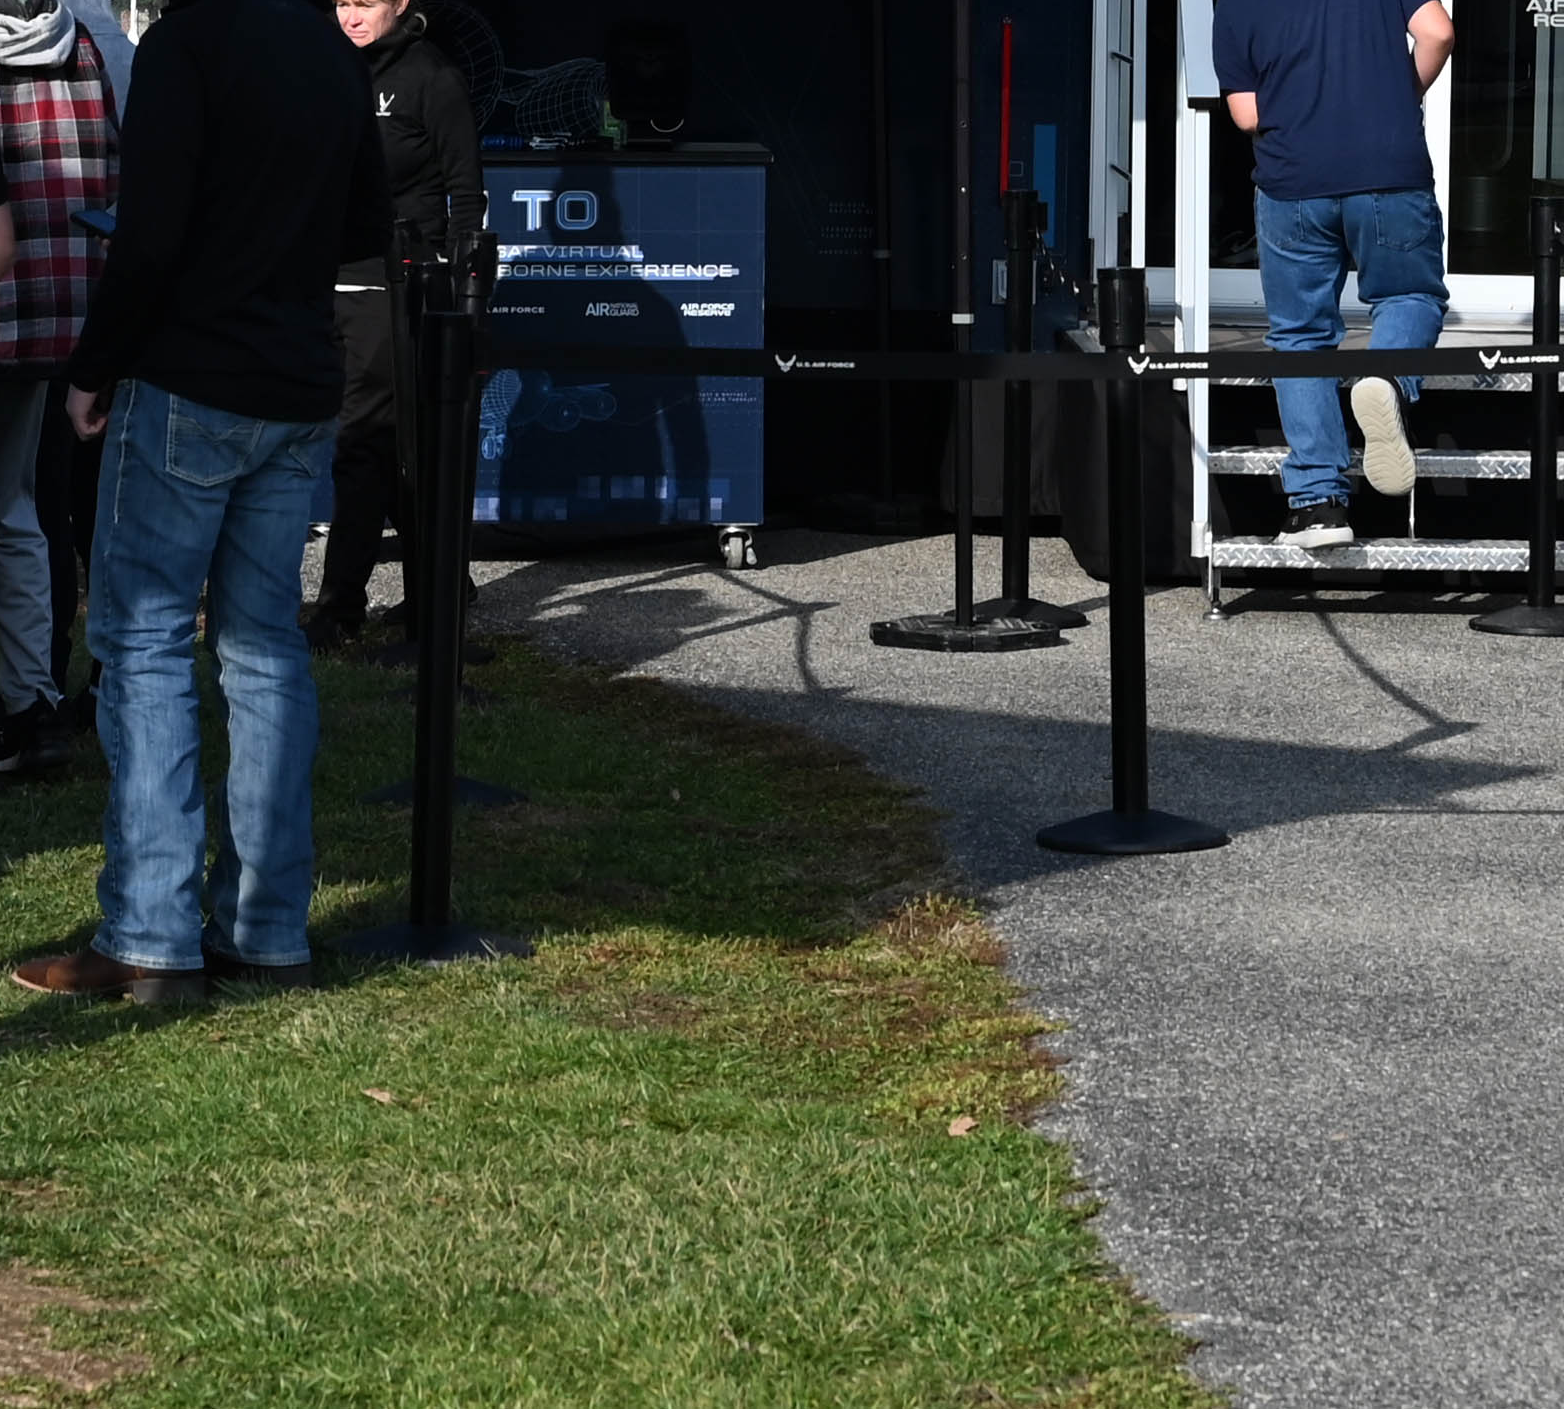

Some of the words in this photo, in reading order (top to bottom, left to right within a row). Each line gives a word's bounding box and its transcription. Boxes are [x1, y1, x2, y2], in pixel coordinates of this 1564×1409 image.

[512, 190, 597, 231] TO
[497, 246, 537, 258] SAF
[543, 246, 643, 258] VIRTUAL
[498, 264, 577, 277] BORNE
[585, 264, 733, 277] EXPERIENCE
[492, 306, 509, 314] AIR
[511, 306, 545, 314] FORCE
[585, 302, 610, 317] AIR
[701, 303, 735, 311] FORCE
